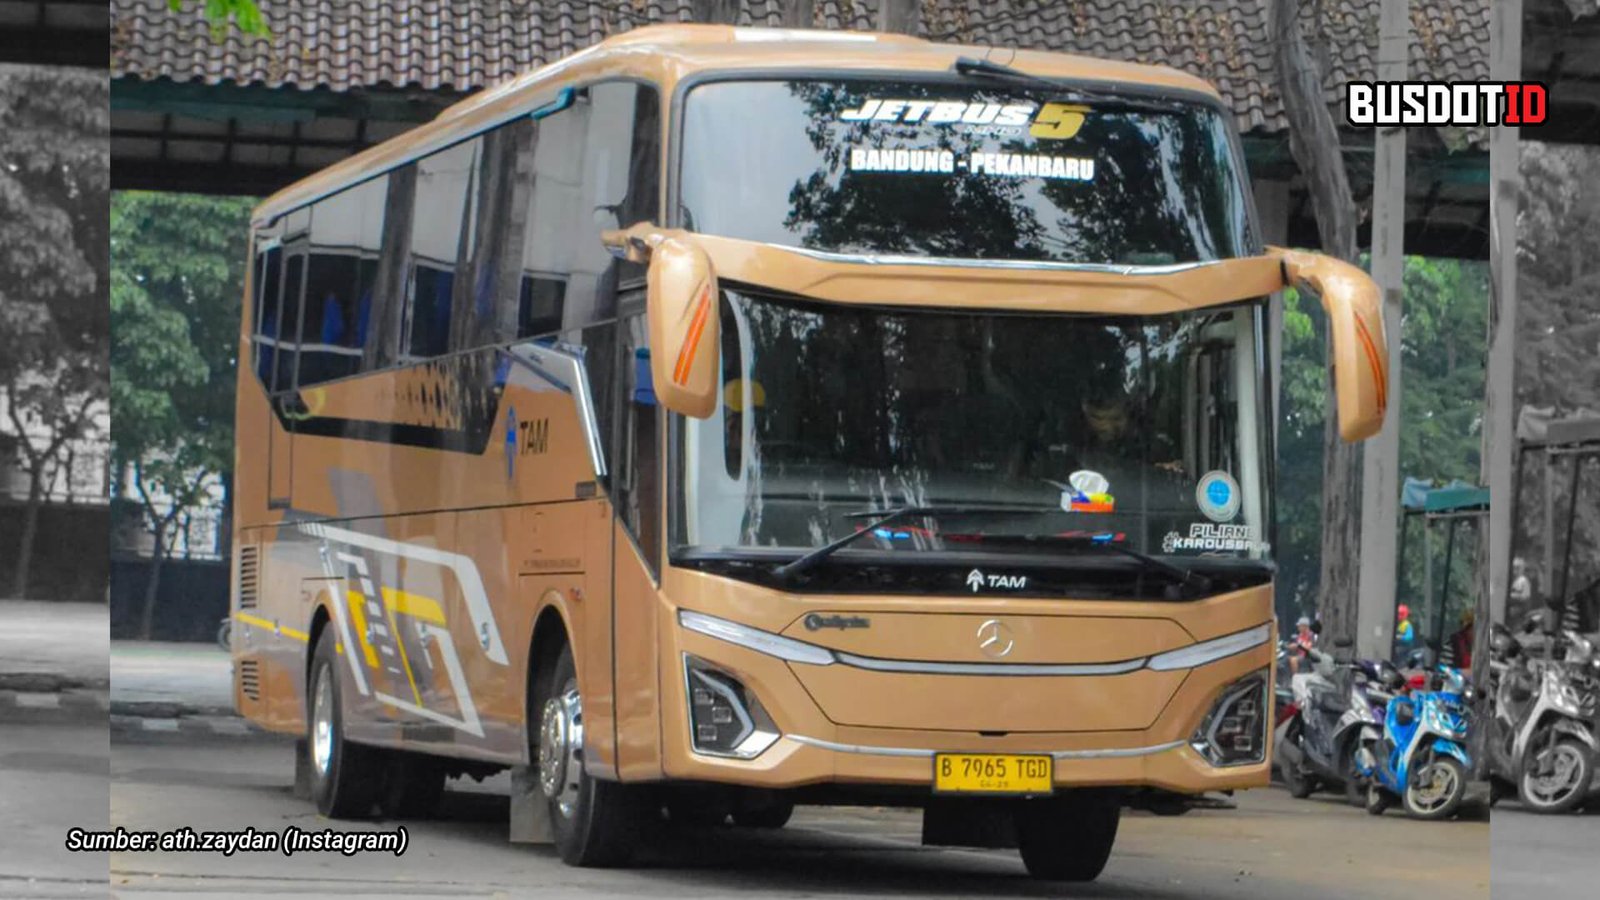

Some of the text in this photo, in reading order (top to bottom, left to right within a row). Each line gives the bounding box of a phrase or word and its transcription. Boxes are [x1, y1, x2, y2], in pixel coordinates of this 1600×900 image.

[840, 99, 1092, 139] JETBUS 5
[851, 149, 954, 173] BANDUNG
[970, 152, 1094, 180] PEKANBARU
[520, 418, 549, 455] TAM
[987, 575, 1026, 588] TAM
[942, 758, 1047, 778] B 7965 TGD
